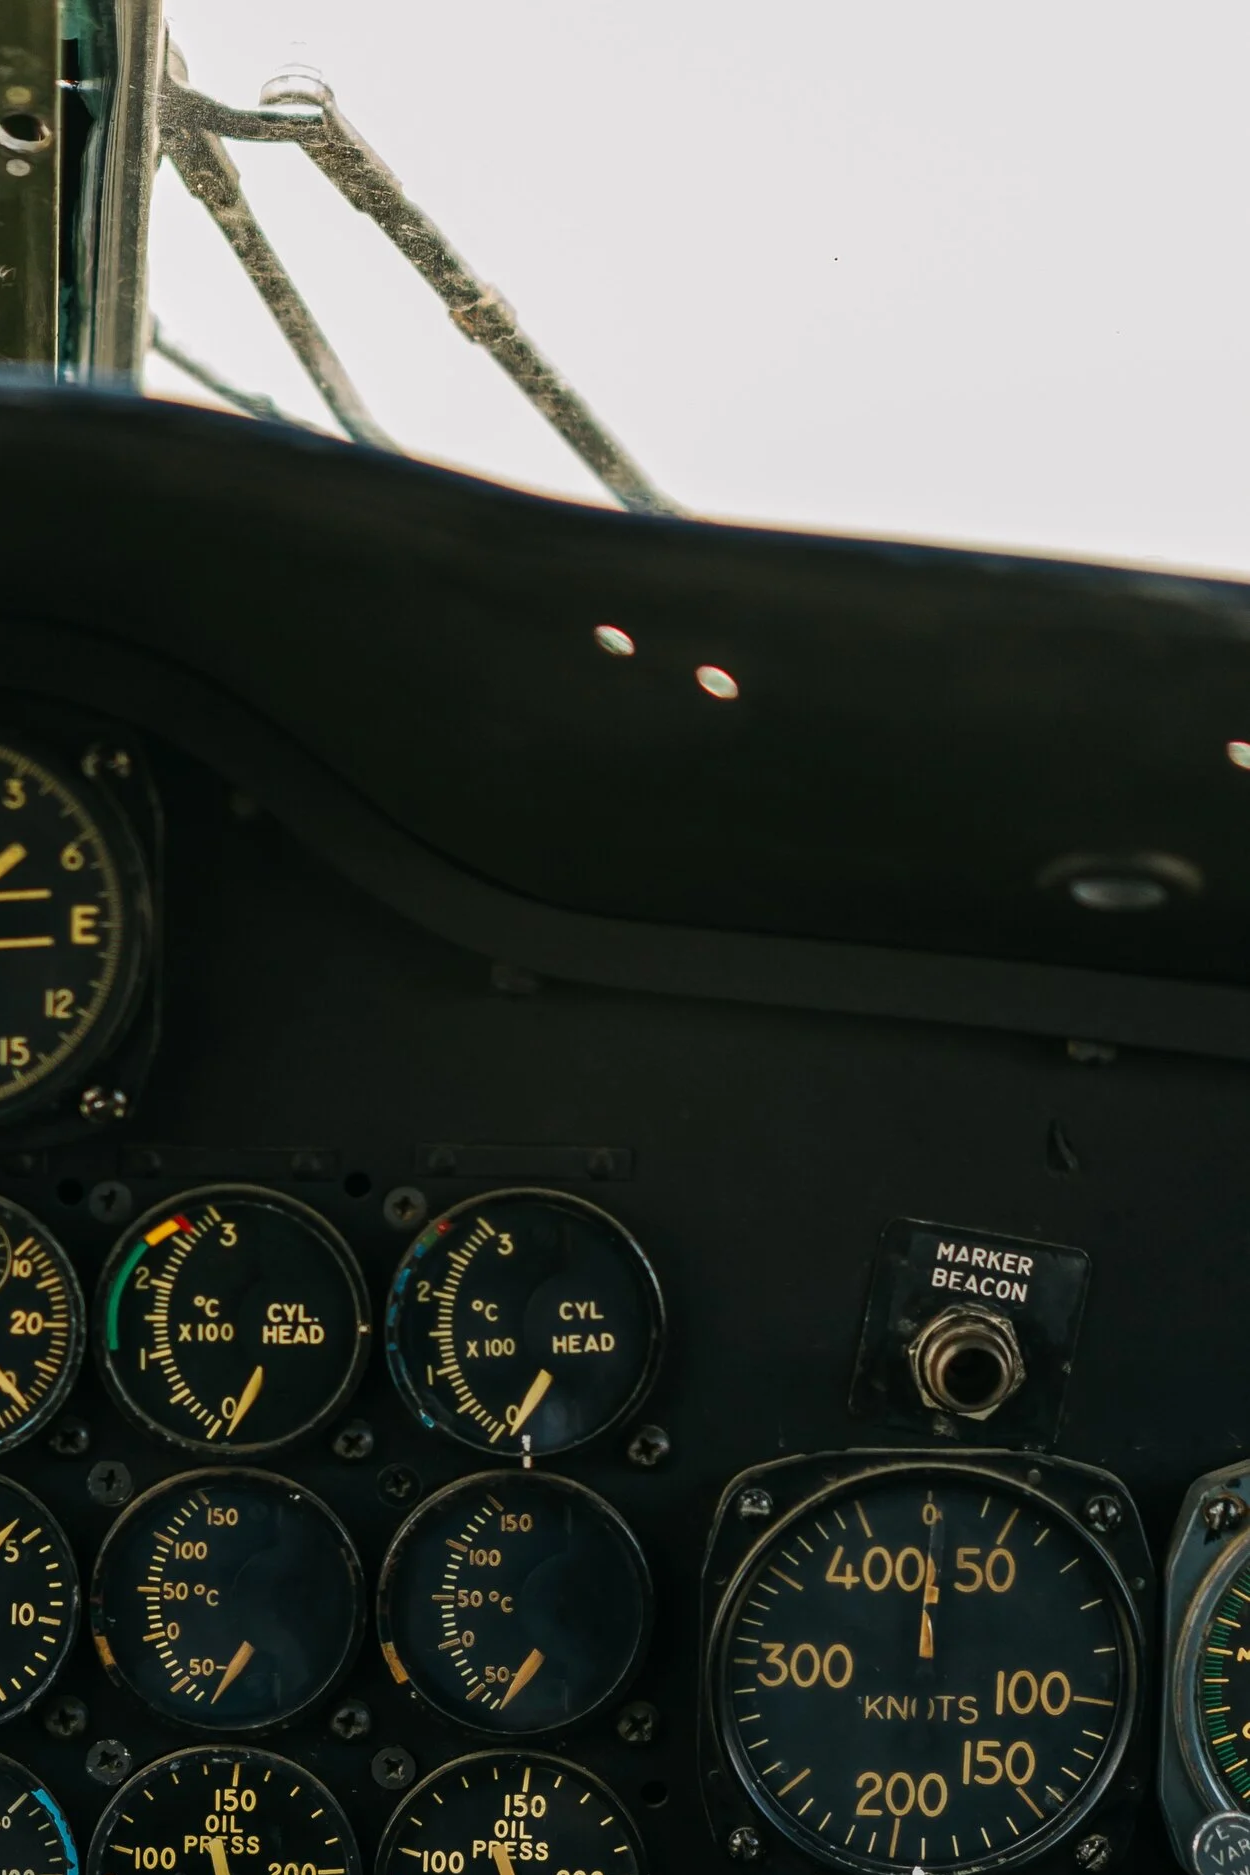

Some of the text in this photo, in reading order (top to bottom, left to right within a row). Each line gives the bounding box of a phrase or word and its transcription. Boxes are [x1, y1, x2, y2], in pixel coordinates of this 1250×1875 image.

[3, 779, 25, 809] 3
[61, 843, 83, 871] 6
[71, 906, 99, 944] E
[45, 990, 74, 1018] 12
[0, 1037, 29, 1065] 15
[937, 1242, 1033, 1276] MARKER
[931, 1267, 1028, 1302] BEACON
[267, 1303, 319, 1323] CYL.
[559, 1301, 604, 1320] CYL
[262, 1325, 325, 1345] HEAD
[552, 1333, 615, 1354] HEAD
[207, 1508, 239, 1526] 150
[501, 1514, 533, 1532] 150
[174, 1541, 207, 1560] 100
[825, 1545, 925, 1592] 400
[954, 1547, 1016, 1593] 50
[163, 1582, 188, 1601] 50
[757, 1643, 853, 1689] 300
[995, 1671, 1071, 1717] 100
[863, 1695, 979, 1724] KNOTS
[963, 1741, 1036, 1785] 150
[215, 1789, 257, 1812] 150
[504, 1794, 547, 1818] 150
[855, 1772, 948, 1817] 200
[205, 1815, 243, 1833] OIL
[494, 1820, 532, 1839] OIL
[134, 1847, 176, 1870] 100
